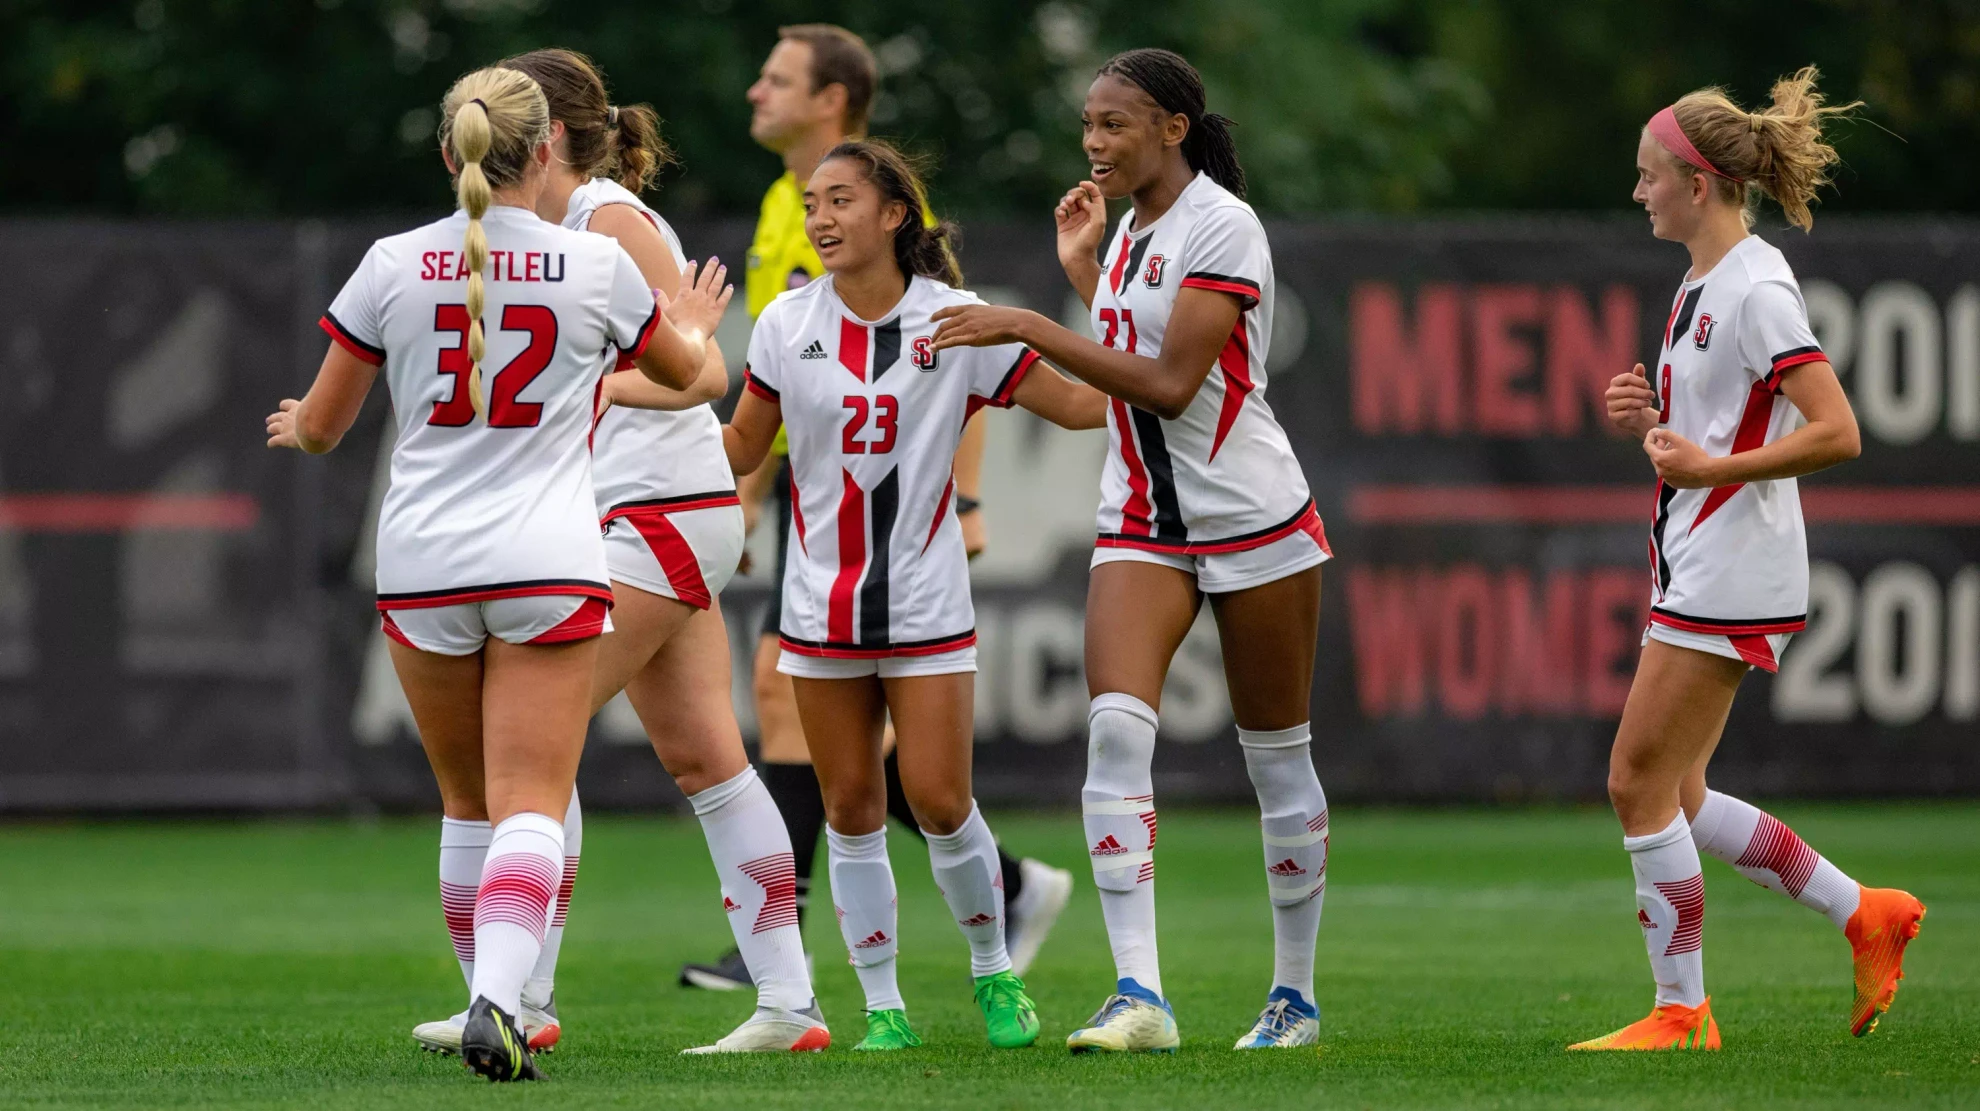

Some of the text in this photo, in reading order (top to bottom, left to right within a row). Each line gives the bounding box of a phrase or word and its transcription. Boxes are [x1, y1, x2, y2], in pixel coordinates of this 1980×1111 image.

[420, 251, 565, 282] SEATLEU
[427, 303, 558, 429] 32
[1350, 282, 1641, 436] MEN
[842, 394, 899, 454] 23
[1346, 565, 1656, 718] WOME
[1091, 847, 1128, 856] adidas
[855, 938, 892, 949] adidas
